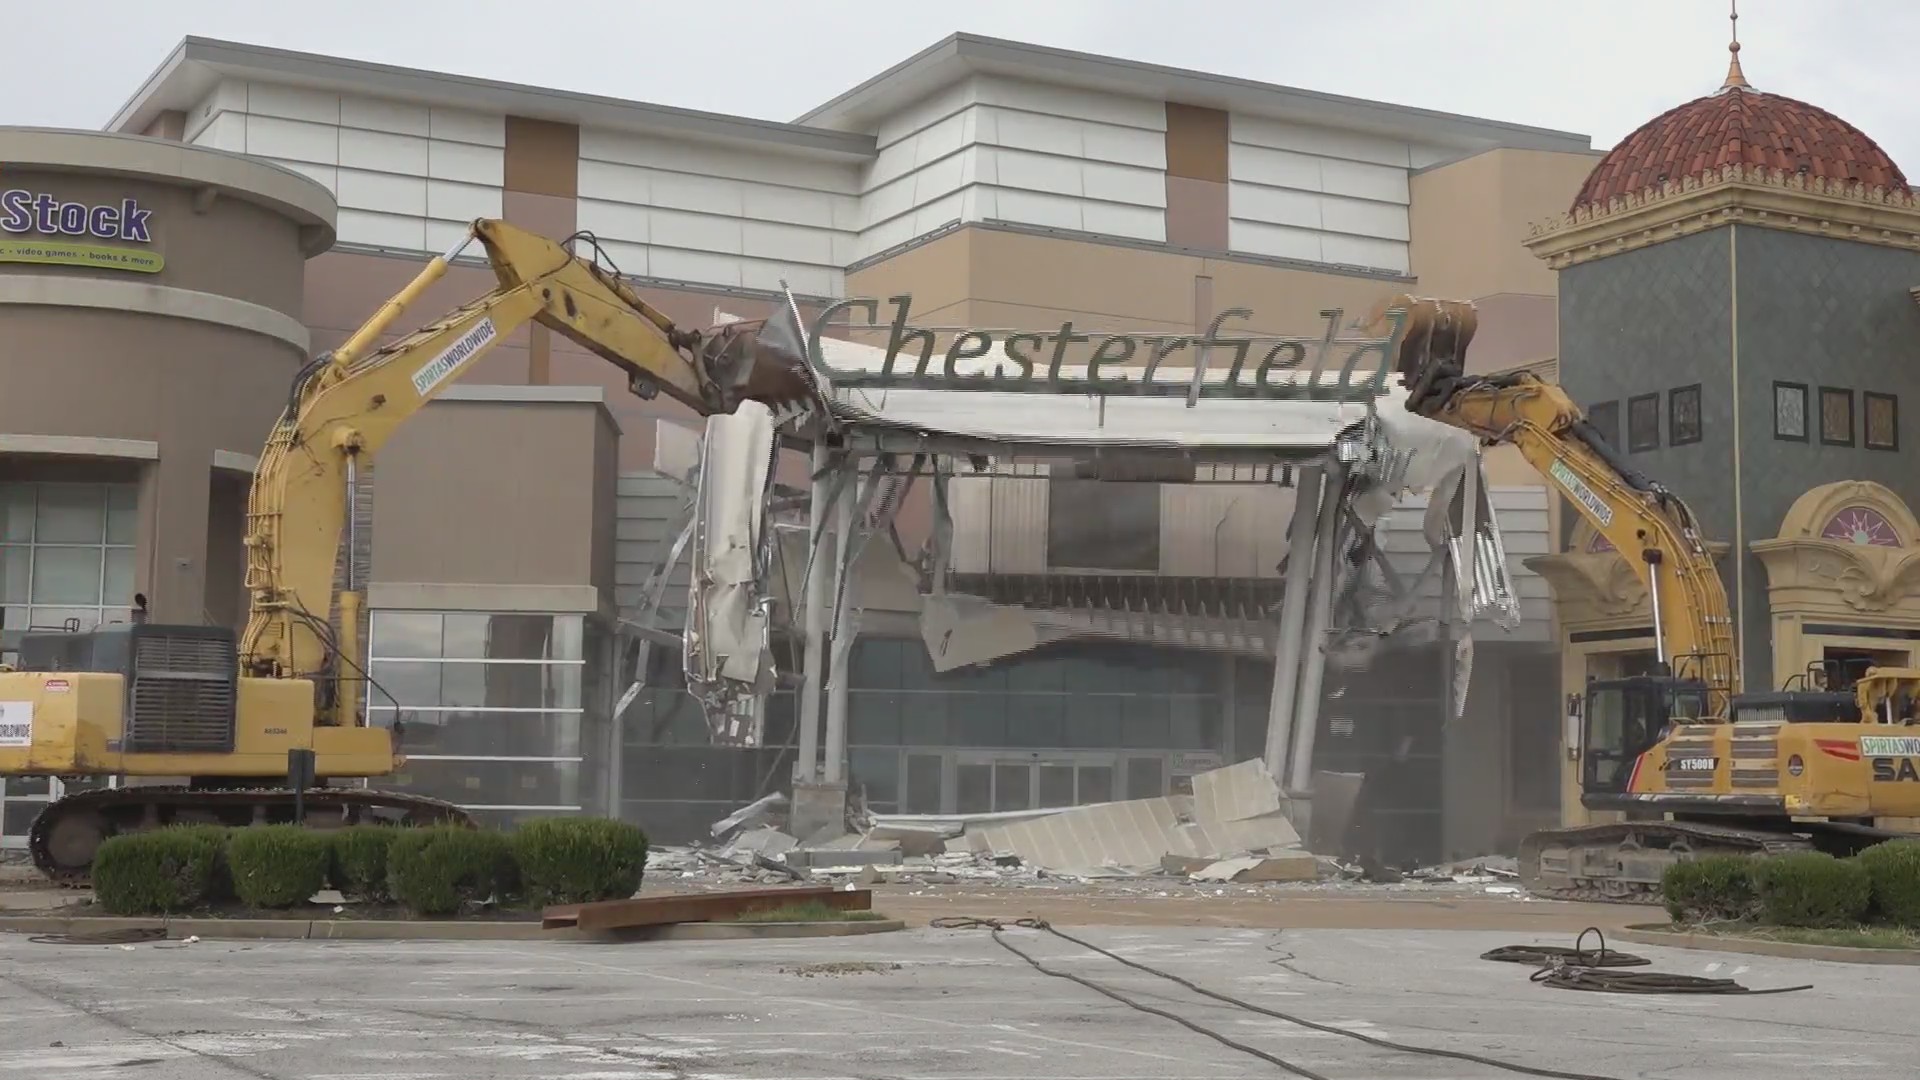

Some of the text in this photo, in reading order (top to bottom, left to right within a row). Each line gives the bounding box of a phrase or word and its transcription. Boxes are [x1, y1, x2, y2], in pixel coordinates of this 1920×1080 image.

[0, 189, 152, 242] Stock
[45, 249, 77, 257] games
[89, 252, 118, 261] books
[131, 257, 154, 265] more
[807, 292, 1408, 396] Chesterfield
[1680, 758, 1714, 770] SY500H
[1872, 758, 1920, 782] SA
